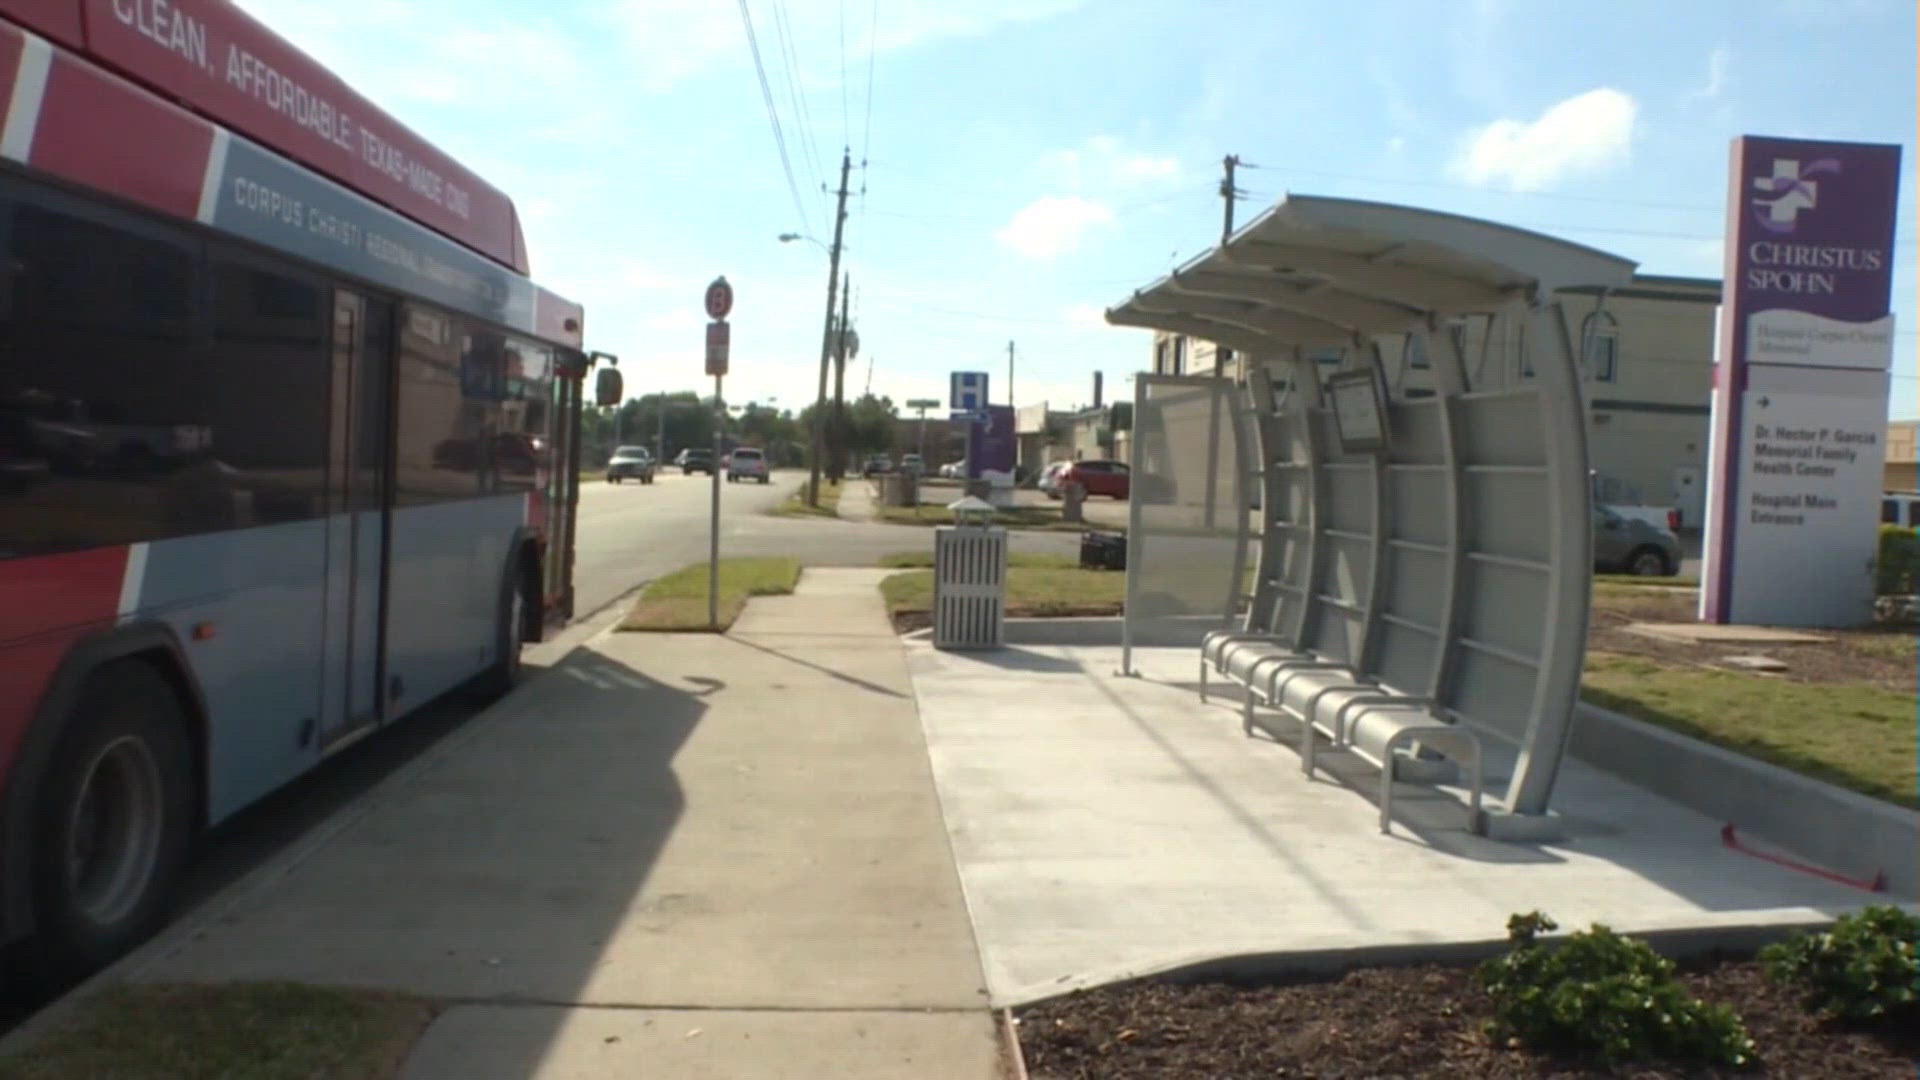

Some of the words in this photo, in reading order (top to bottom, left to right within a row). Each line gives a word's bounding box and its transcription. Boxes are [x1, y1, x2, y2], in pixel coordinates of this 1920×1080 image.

[234, 176, 303, 228] CORPUS
[308, 207, 361, 247] CHRISTI
[1750, 240, 1882, 270] CHRISTUS
[1748, 268, 1835, 294] SPOHN
[957, 375, 984, 406] H
[1776, 427, 1816, 441] Hector
[1834, 429, 1876, 444] Garcia
[1755, 443, 1813, 458] Memorial
[1815, 446, 1857, 463] Family
[1753, 461, 1793, 474] Health
[1796, 463, 1836, 477] Center
[1751, 493, 1802, 509] Hospital
[1804, 494, 1837, 508] Main
[1750, 510, 1805, 525] Entrance
